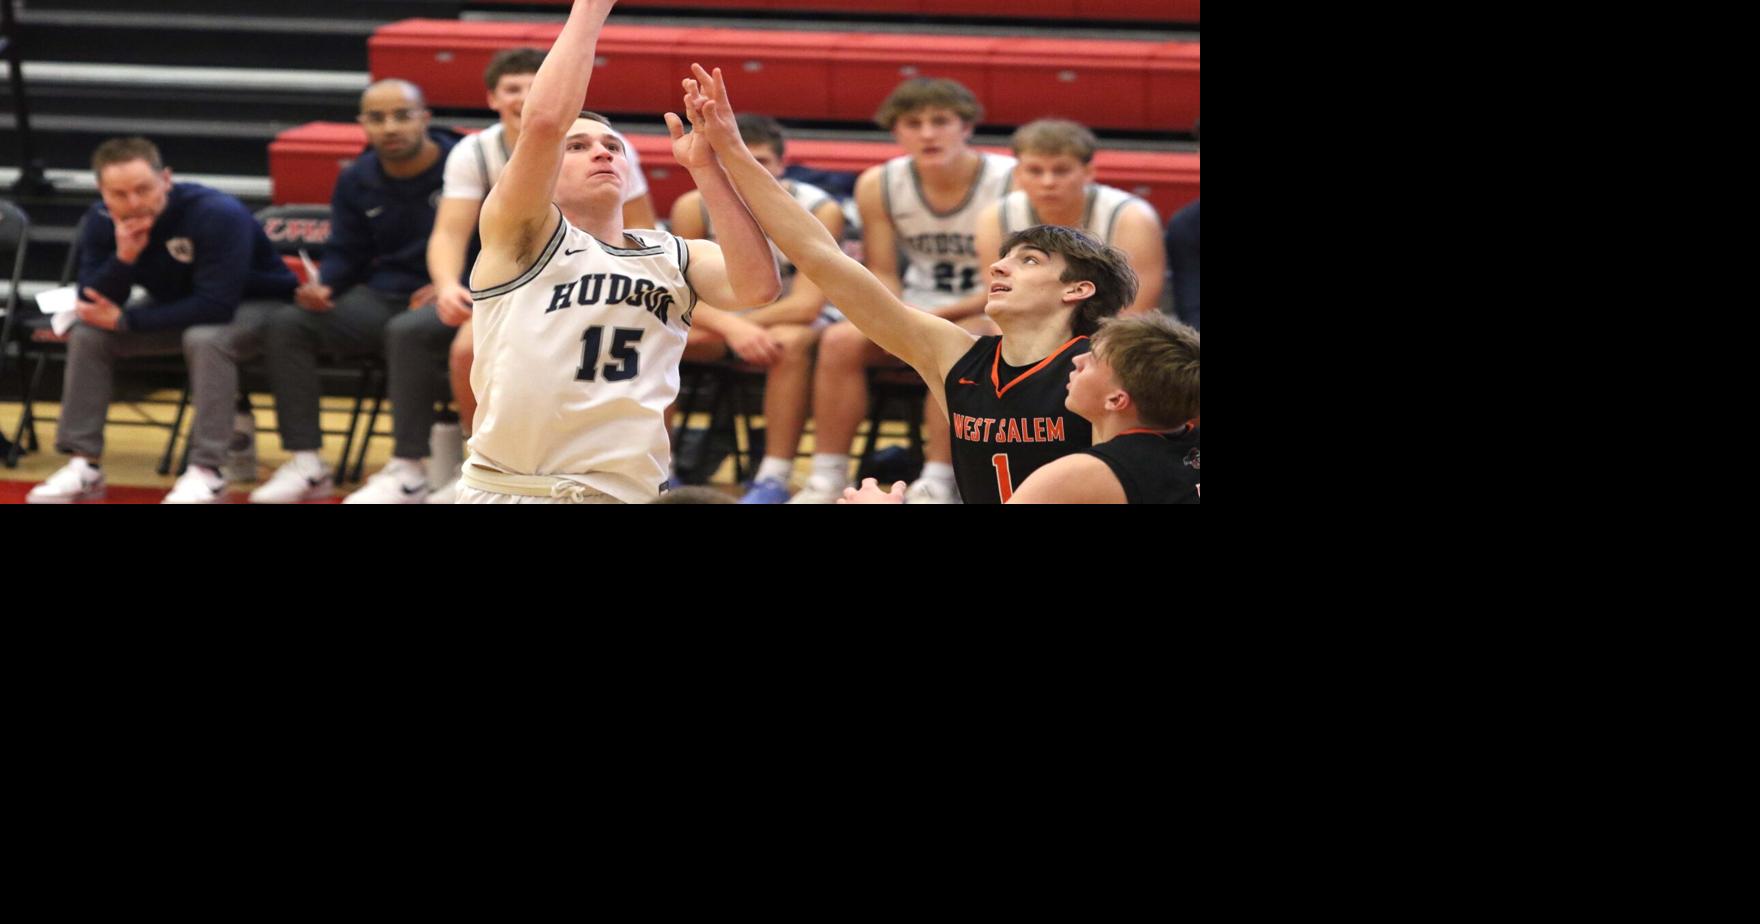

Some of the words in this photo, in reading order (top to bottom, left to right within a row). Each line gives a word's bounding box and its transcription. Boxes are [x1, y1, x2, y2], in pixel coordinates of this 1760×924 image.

[574, 324, 645, 384] 15
[953, 412, 996, 443] WEST
[995, 416, 1065, 443] SALEM
[992, 453, 1014, 504] 1
